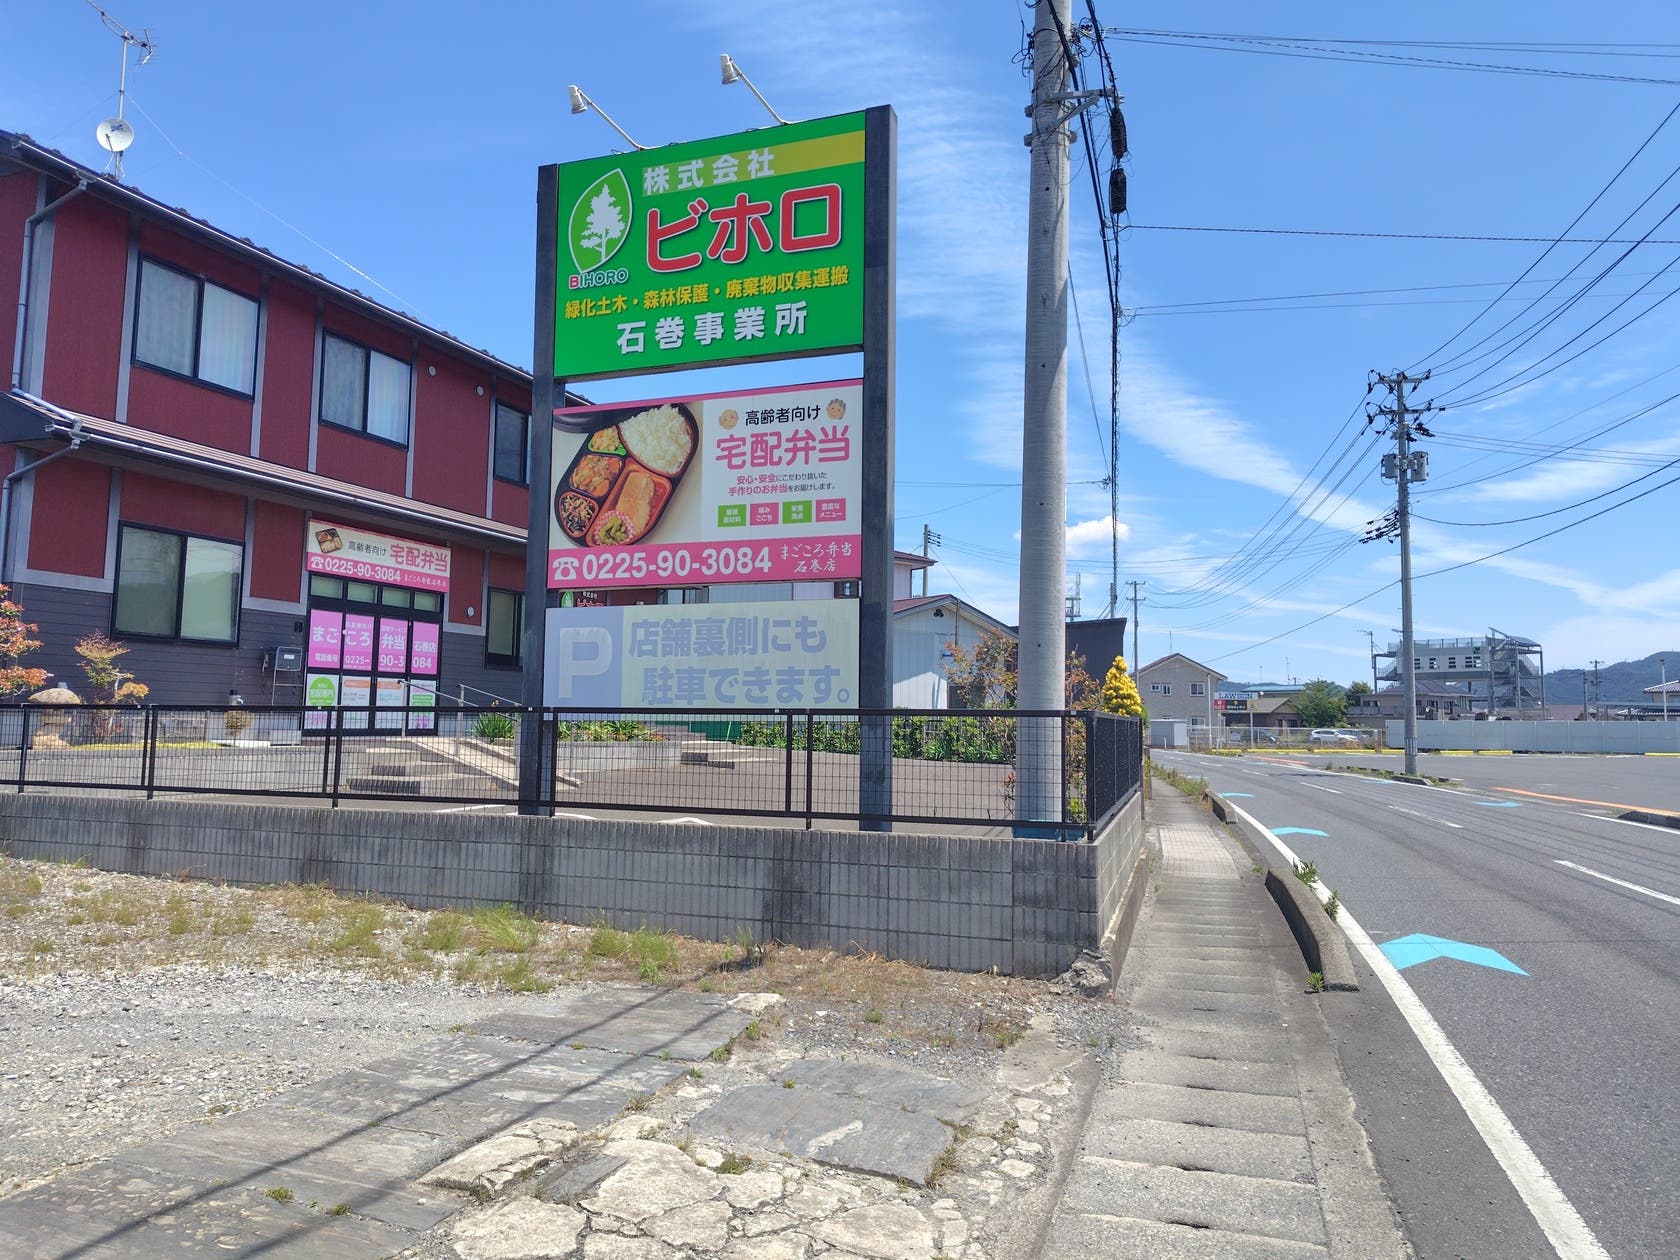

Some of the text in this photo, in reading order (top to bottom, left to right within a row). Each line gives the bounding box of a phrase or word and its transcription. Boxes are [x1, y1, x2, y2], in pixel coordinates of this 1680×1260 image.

[644, 148, 775, 195] 株式会社
[646, 183, 842, 273] ビホロ
[565, 265, 849, 319] 緑化土木・森林保護・廃棄物収集運搬
[568, 268, 629, 290] BIHORO
[616, 301, 807, 355] 石巻事業所
[745, 405, 821, 427] 高齢者向け
[715, 425, 850, 470] 宅配弁当
[325, 558, 401, 582] 0225-90-3084
[390, 544, 448, 573] 宅配弁当
[582, 547, 772, 581] 0225-90-3084
[780, 541, 852, 560] まごころ弁当
[794, 559, 836, 573] 石巻店
[629, 615, 827, 658] 店舗裏側にも
[558, 627, 613, 699] P
[642, 665, 850, 706] 駐車できます。
